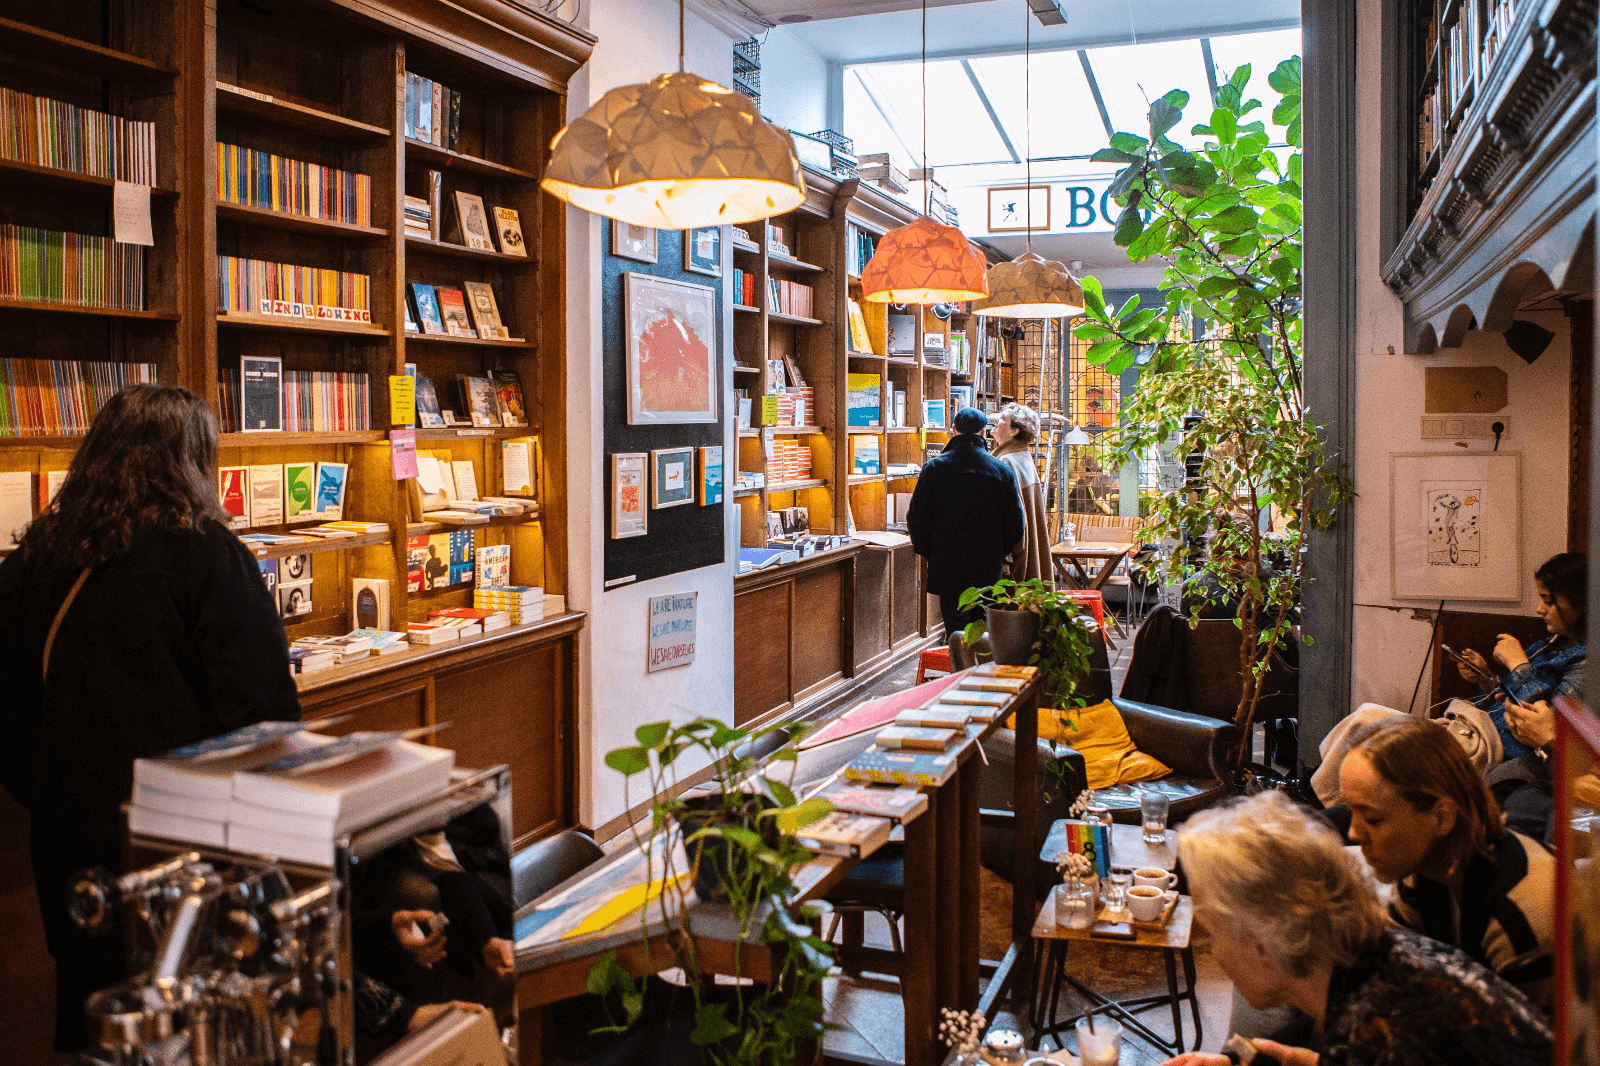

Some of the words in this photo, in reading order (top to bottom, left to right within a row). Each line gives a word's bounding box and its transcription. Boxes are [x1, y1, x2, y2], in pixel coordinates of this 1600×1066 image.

[471, 238, 482, 248] 10
[485, 555, 508, 565] AMERICAN
[661, 598, 671, 612] ARE
[671, 619, 693, 633] NATURE
[1083, 841, 1096, 862] 8
